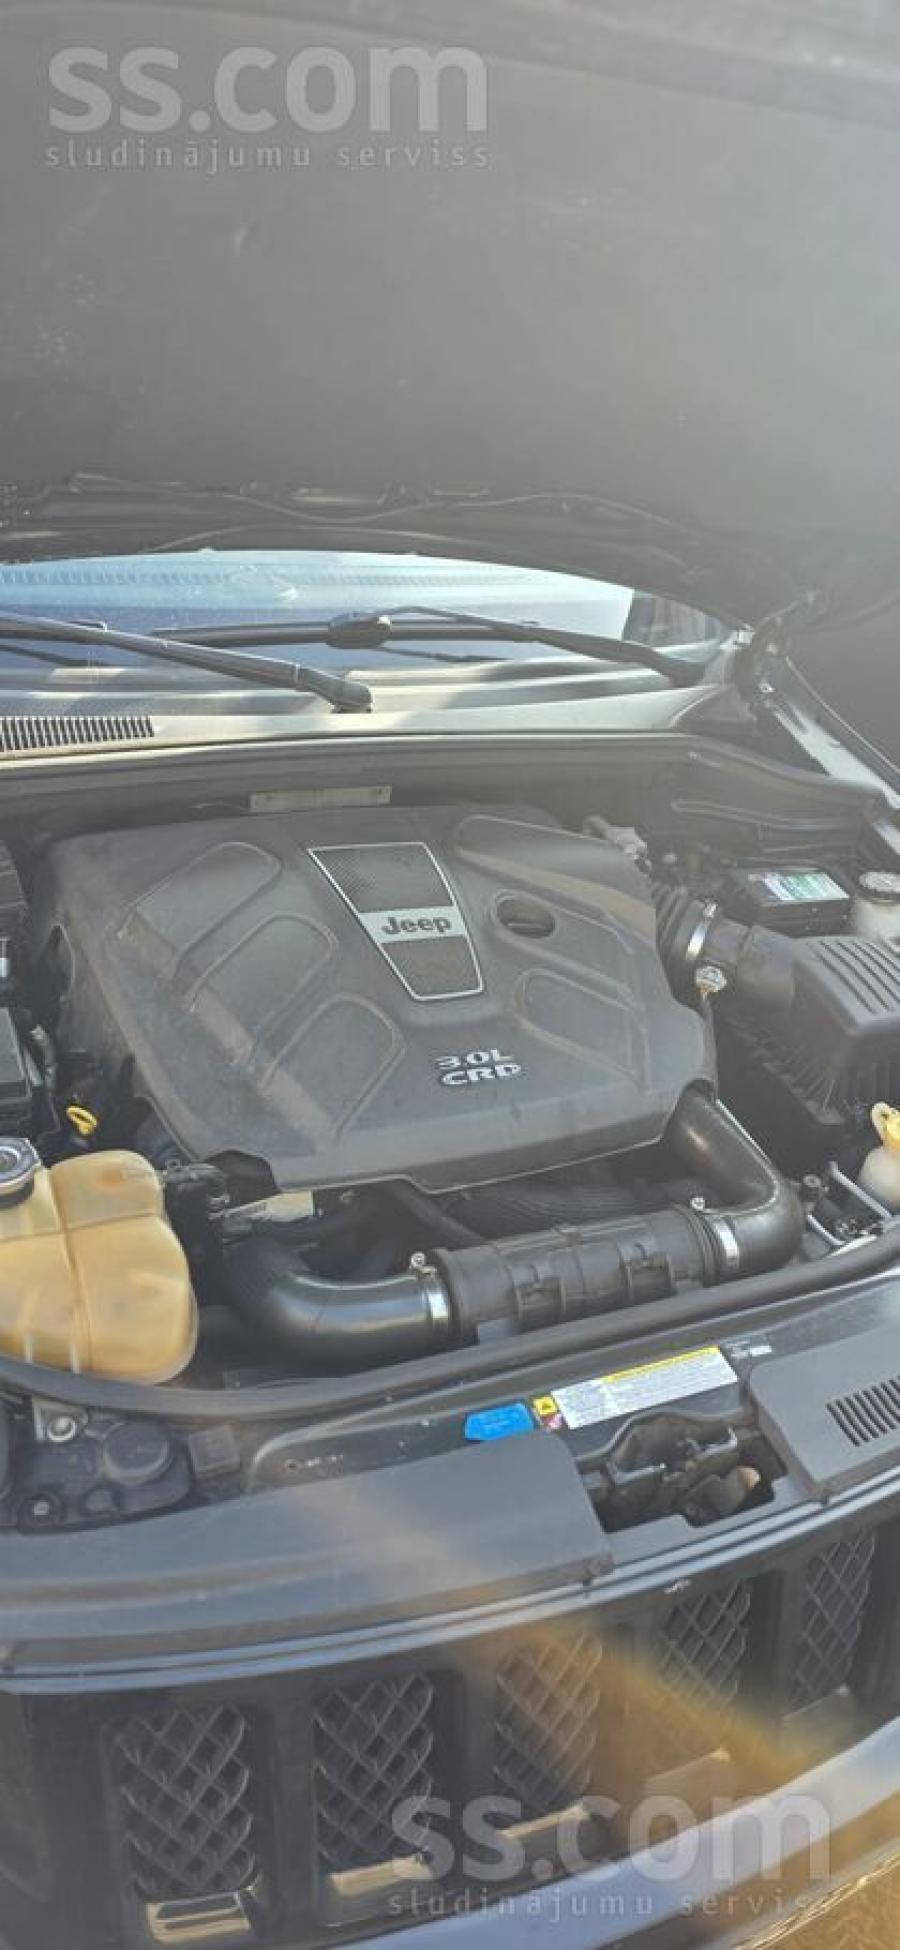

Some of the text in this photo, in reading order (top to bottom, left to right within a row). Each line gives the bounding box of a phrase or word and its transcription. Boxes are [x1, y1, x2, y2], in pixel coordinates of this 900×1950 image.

[382, 916, 451, 935] Jeep
[435, 1049, 514, 1070] 3.0L
[441, 1063, 522, 1085] CRD
